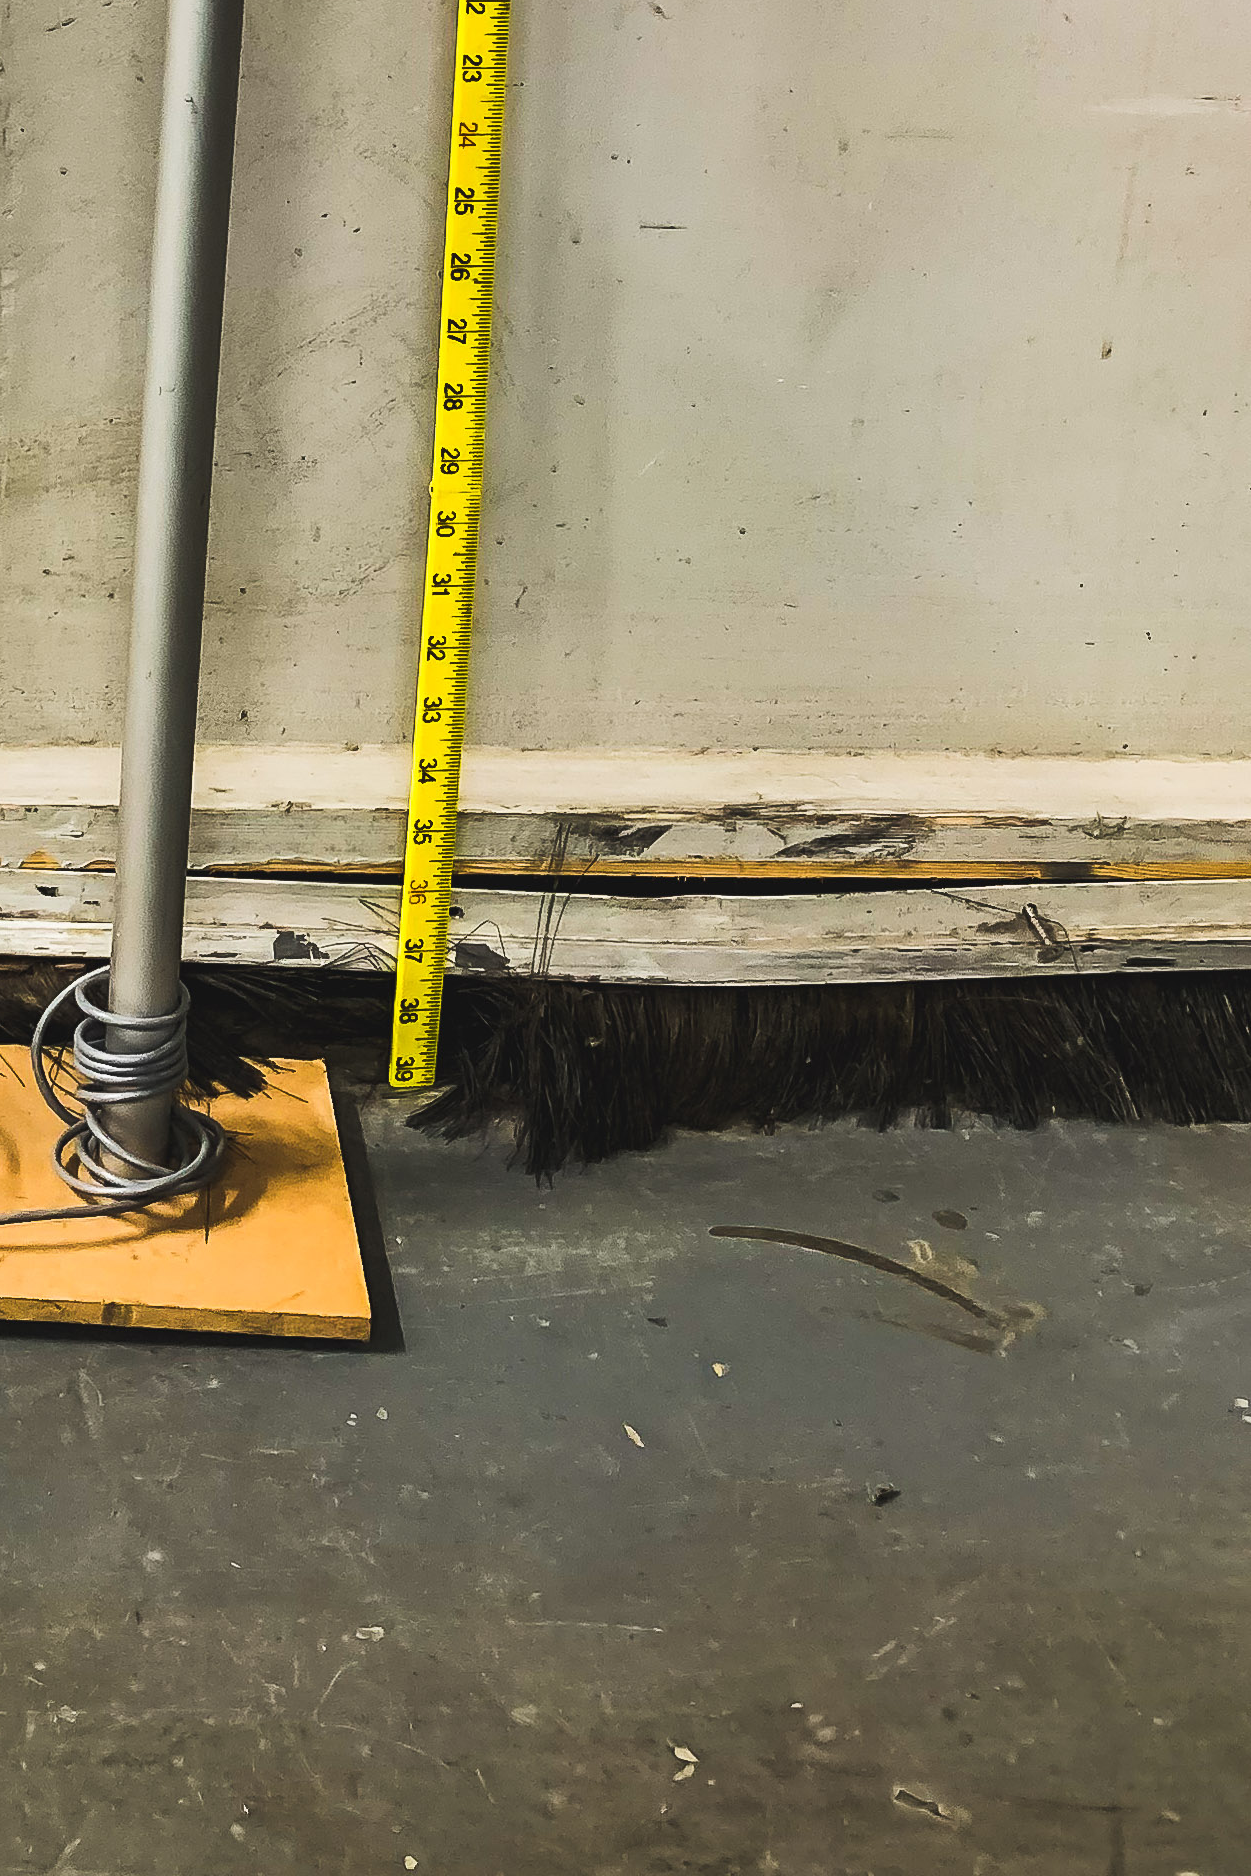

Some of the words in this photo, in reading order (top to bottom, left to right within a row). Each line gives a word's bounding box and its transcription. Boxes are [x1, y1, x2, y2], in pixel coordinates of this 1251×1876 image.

[462, 54, 483, 82] 23
[459, 122, 478, 149] 24
[454, 187, 475, 215] 25
[450, 253, 472, 282] 26
[447, 318, 467, 344] 27
[443, 383, 463, 411] 28
[440, 447, 460, 475] 29
[436, 510, 456, 538] 30
[432, 573, 452, 595] 31
[427, 635, 446, 661] 32
[422, 696, 442, 723] 33
[418, 758, 437, 784] 34
[413, 819, 433, 845] 35
[409, 880, 428, 905] 36
[405, 938, 424, 964] 37
[399, 998, 420, 1024] 38
[395, 1056, 415, 1082] 39
